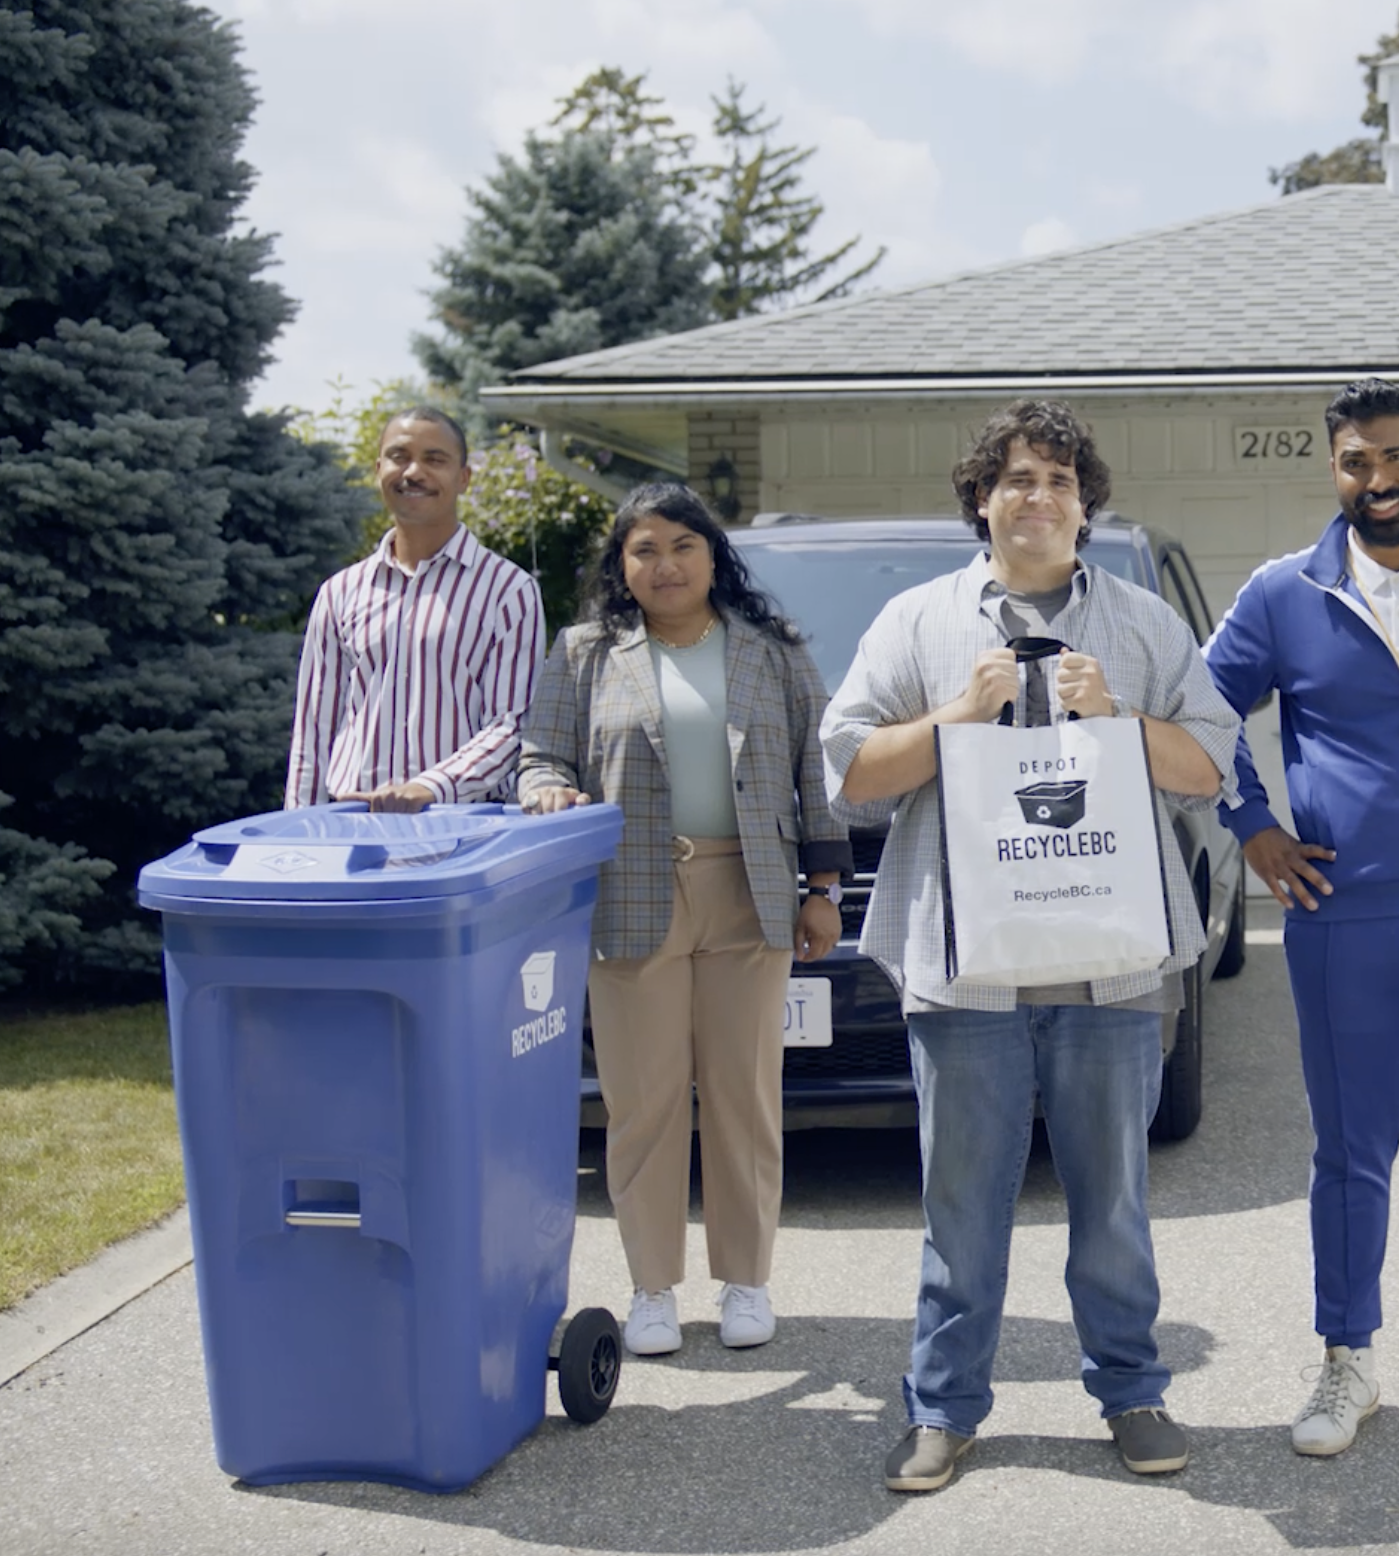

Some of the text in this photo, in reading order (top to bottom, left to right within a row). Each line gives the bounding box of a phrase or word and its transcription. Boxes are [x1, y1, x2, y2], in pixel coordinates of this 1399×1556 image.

[1240, 430, 1314, 459] 2182
[1019, 757, 1076, 774] DEPOT
[997, 831, 1117, 862] RECYCLEBC
[1014, 885, 1112, 902] RecycleBC.ca
[511, 1006, 567, 1059] RECYCLEBC
